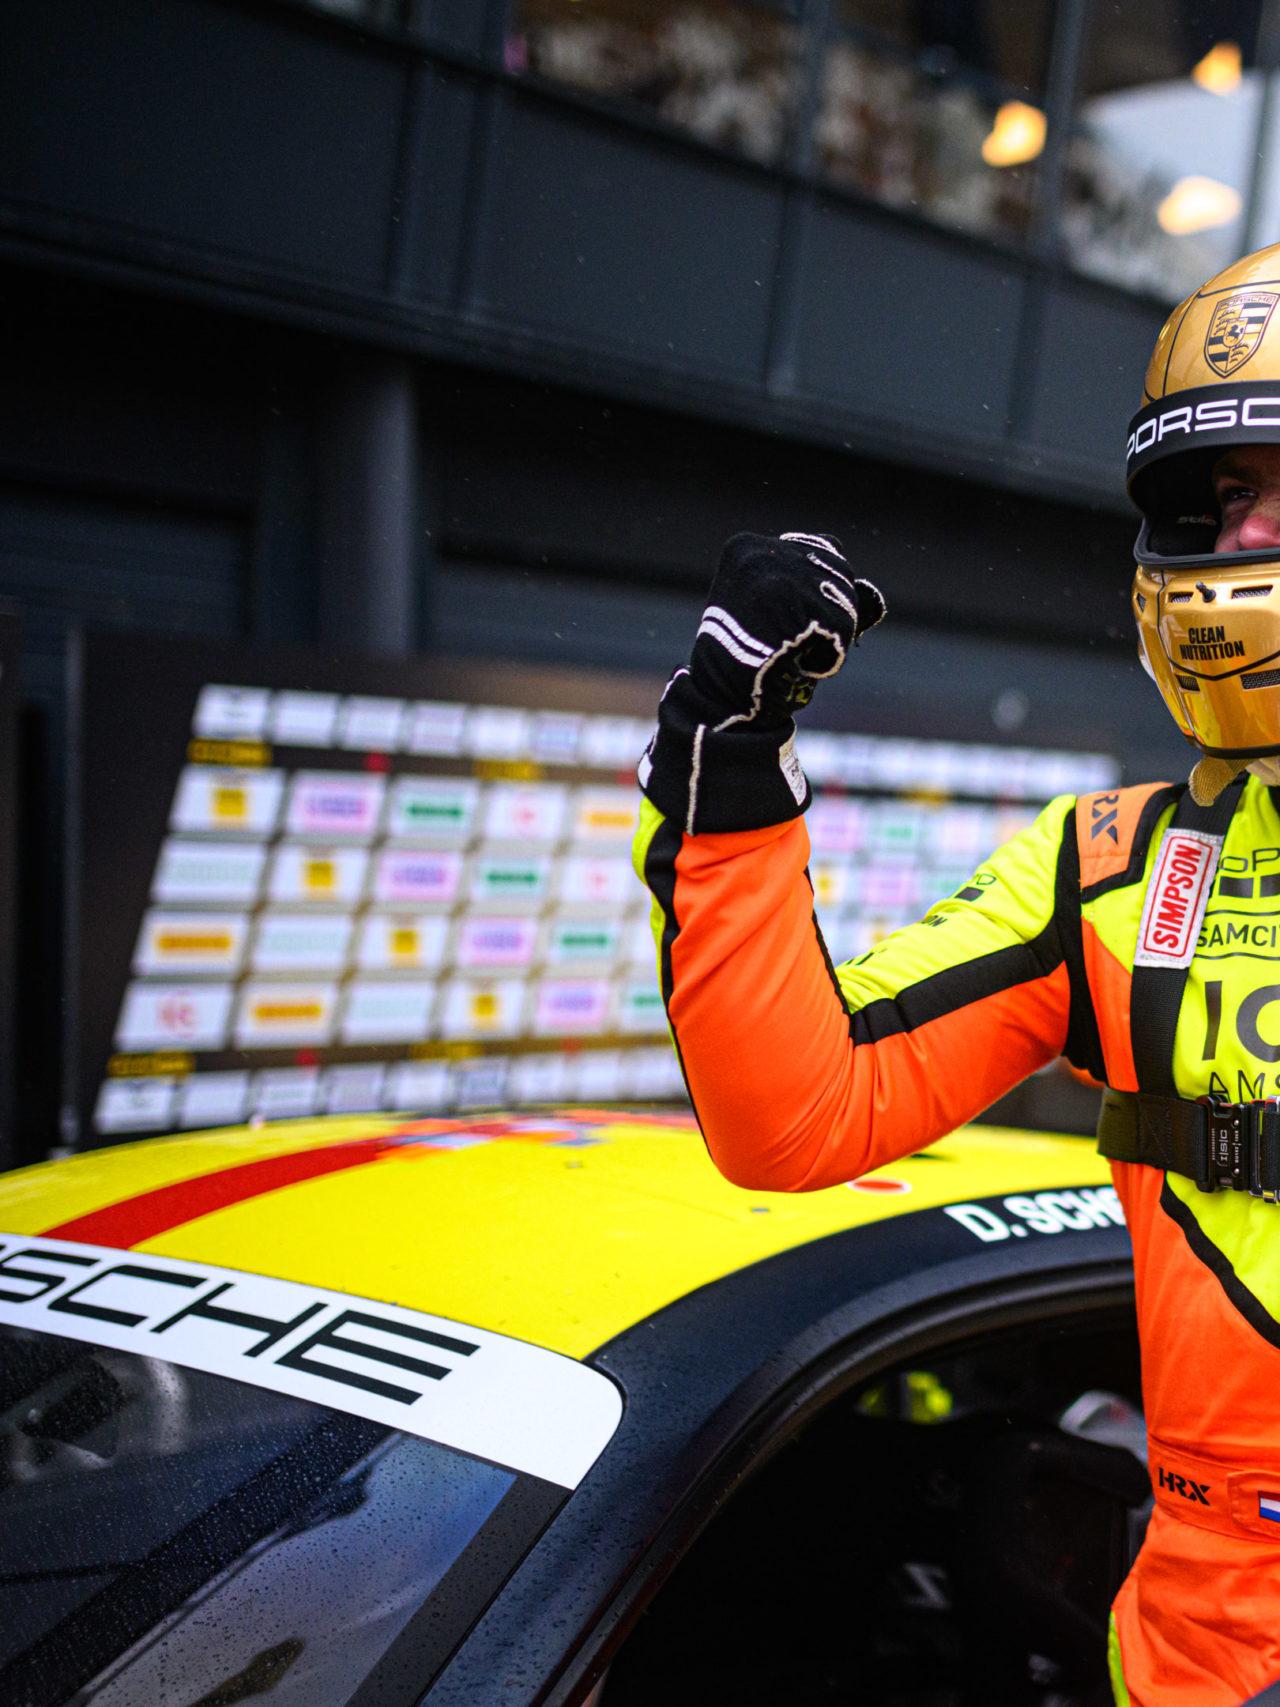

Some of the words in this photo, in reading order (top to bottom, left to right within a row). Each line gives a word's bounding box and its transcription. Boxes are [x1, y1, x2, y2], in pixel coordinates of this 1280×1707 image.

[1179, 641, 1246, 661] NUTRITION
[1188, 625, 1226, 644] CLEAN
[1152, 842, 1203, 949] SIMPSON
[0, 1244, 482, 1407] SCHE
[1158, 1466, 1211, 1507] HRX
